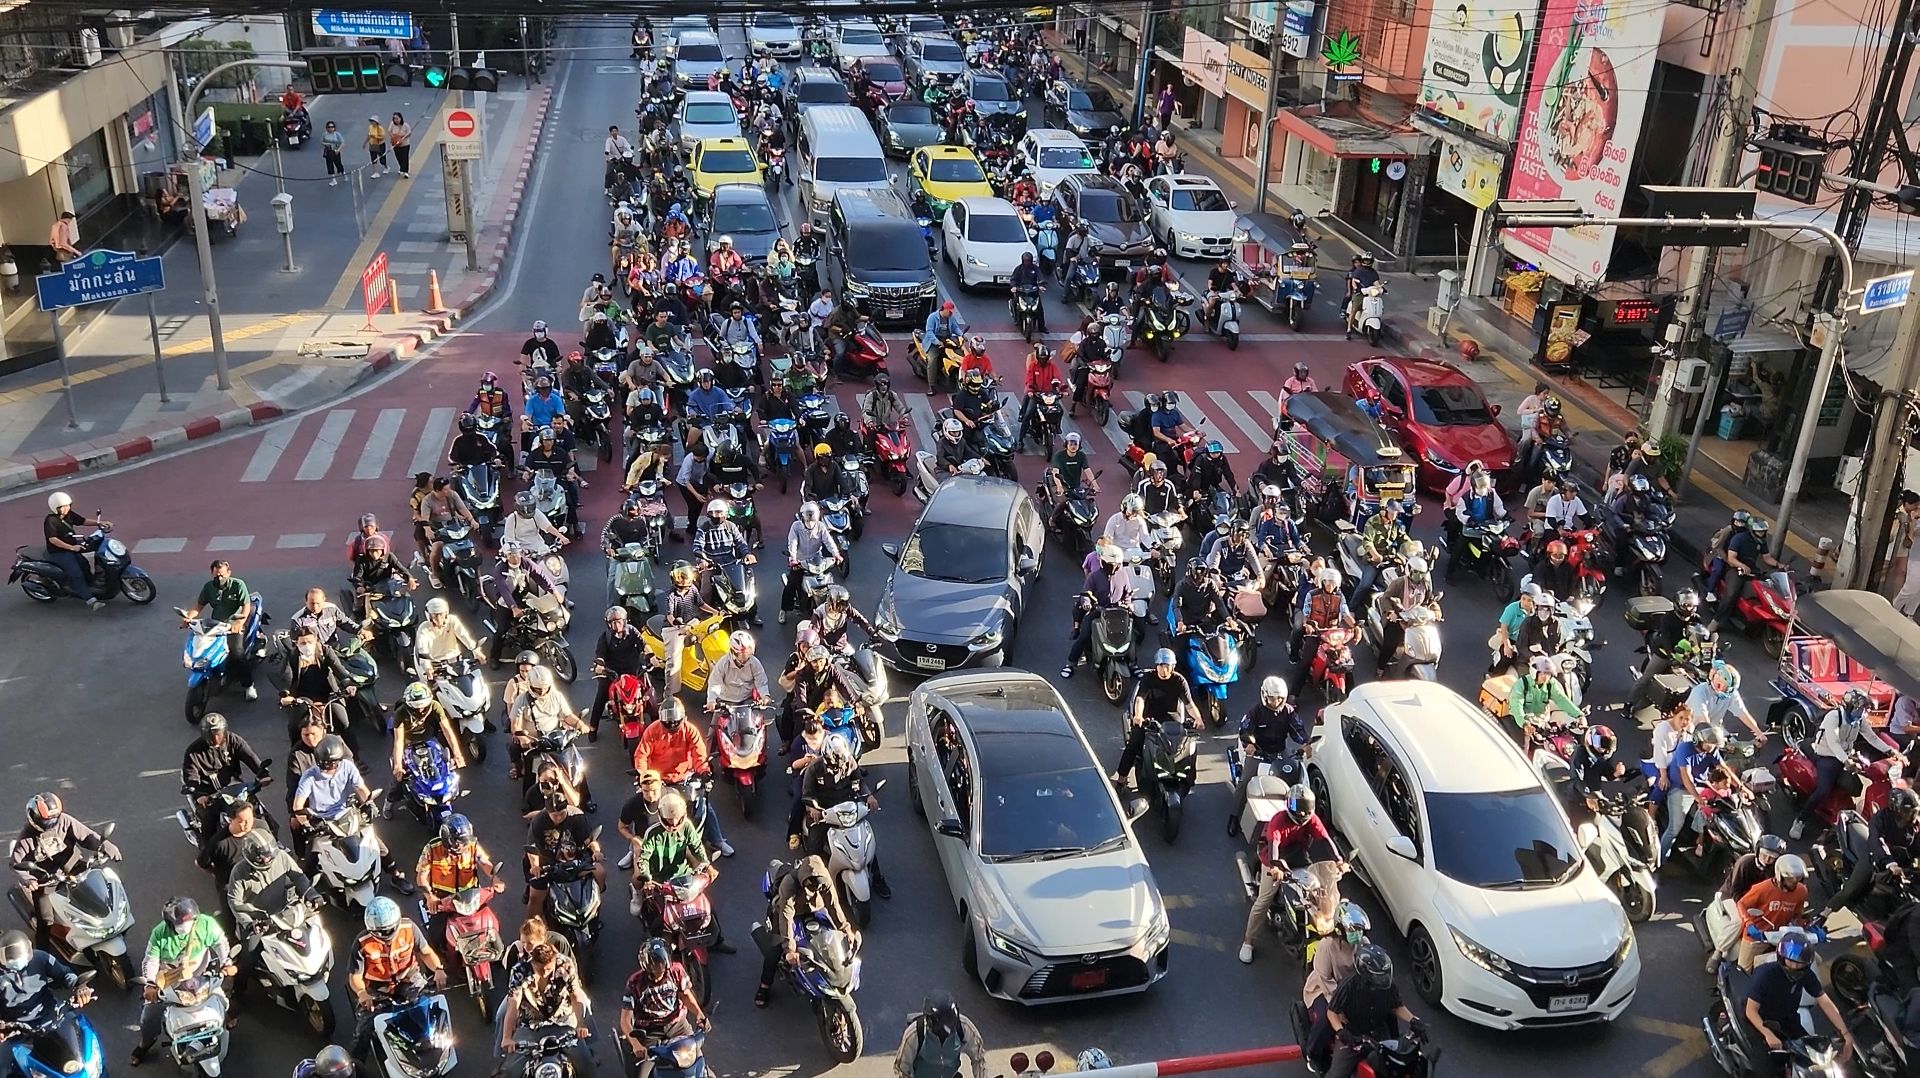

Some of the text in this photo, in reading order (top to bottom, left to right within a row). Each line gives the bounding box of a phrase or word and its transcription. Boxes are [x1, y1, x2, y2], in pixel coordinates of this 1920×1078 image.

[330, 25, 355, 33] Nikhom
[359, 26, 391, 35] Makkasan
[1245, 67, 1268, 91] INDEED
[1519, 157, 1547, 181] TASTE
[68, 265, 136, 292] มักกะสัน
[81, 287, 128, 302] Makkasan
